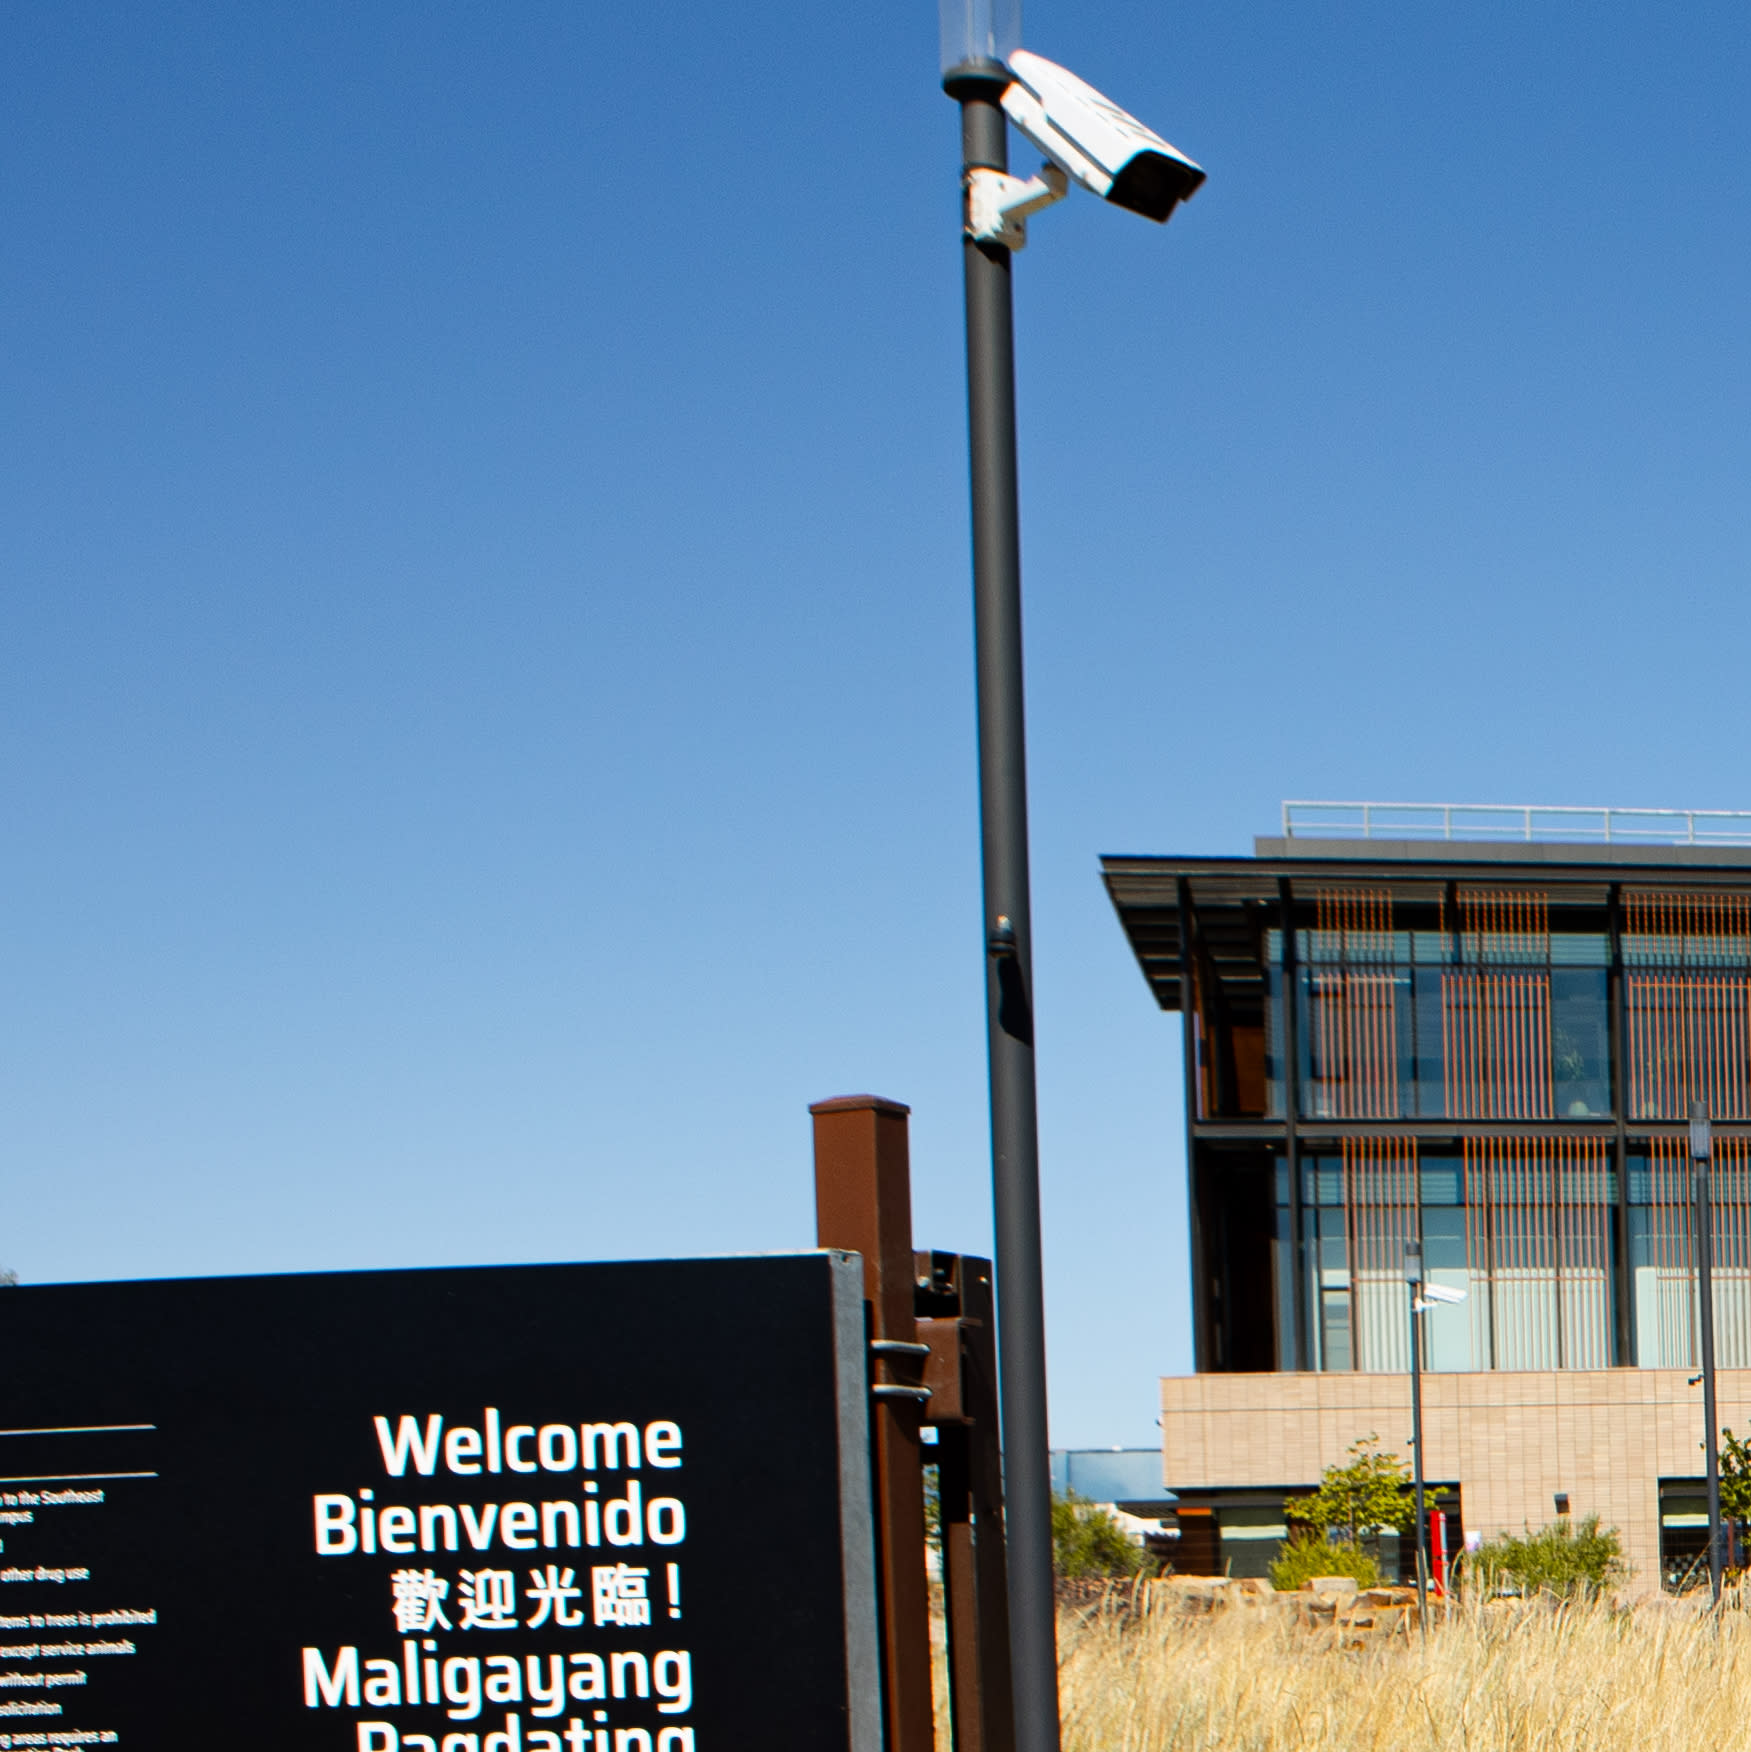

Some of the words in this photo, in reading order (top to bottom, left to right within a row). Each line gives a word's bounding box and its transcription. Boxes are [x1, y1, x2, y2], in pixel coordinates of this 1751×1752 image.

[374, 1407, 683, 1476] Welcome
[40, 1488, 105, 1504] Southeast
[313, 1481, 686, 1555] Bienvenido
[34, 1566, 66, 1583] drug
[65, 1567, 90, 1580] use
[45, 1613, 79, 1627] trees
[78, 1610, 92, 1626] is
[91, 1608, 157, 1628] prohibited
[40, 1641, 85, 1657] service
[85, 1639, 137, 1655] animals
[44, 1669, 88, 1688] permit
[302, 1640, 693, 1719] Maligayang
[47, 1729, 100, 1746] requires
[99, 1731, 119, 1743] an
